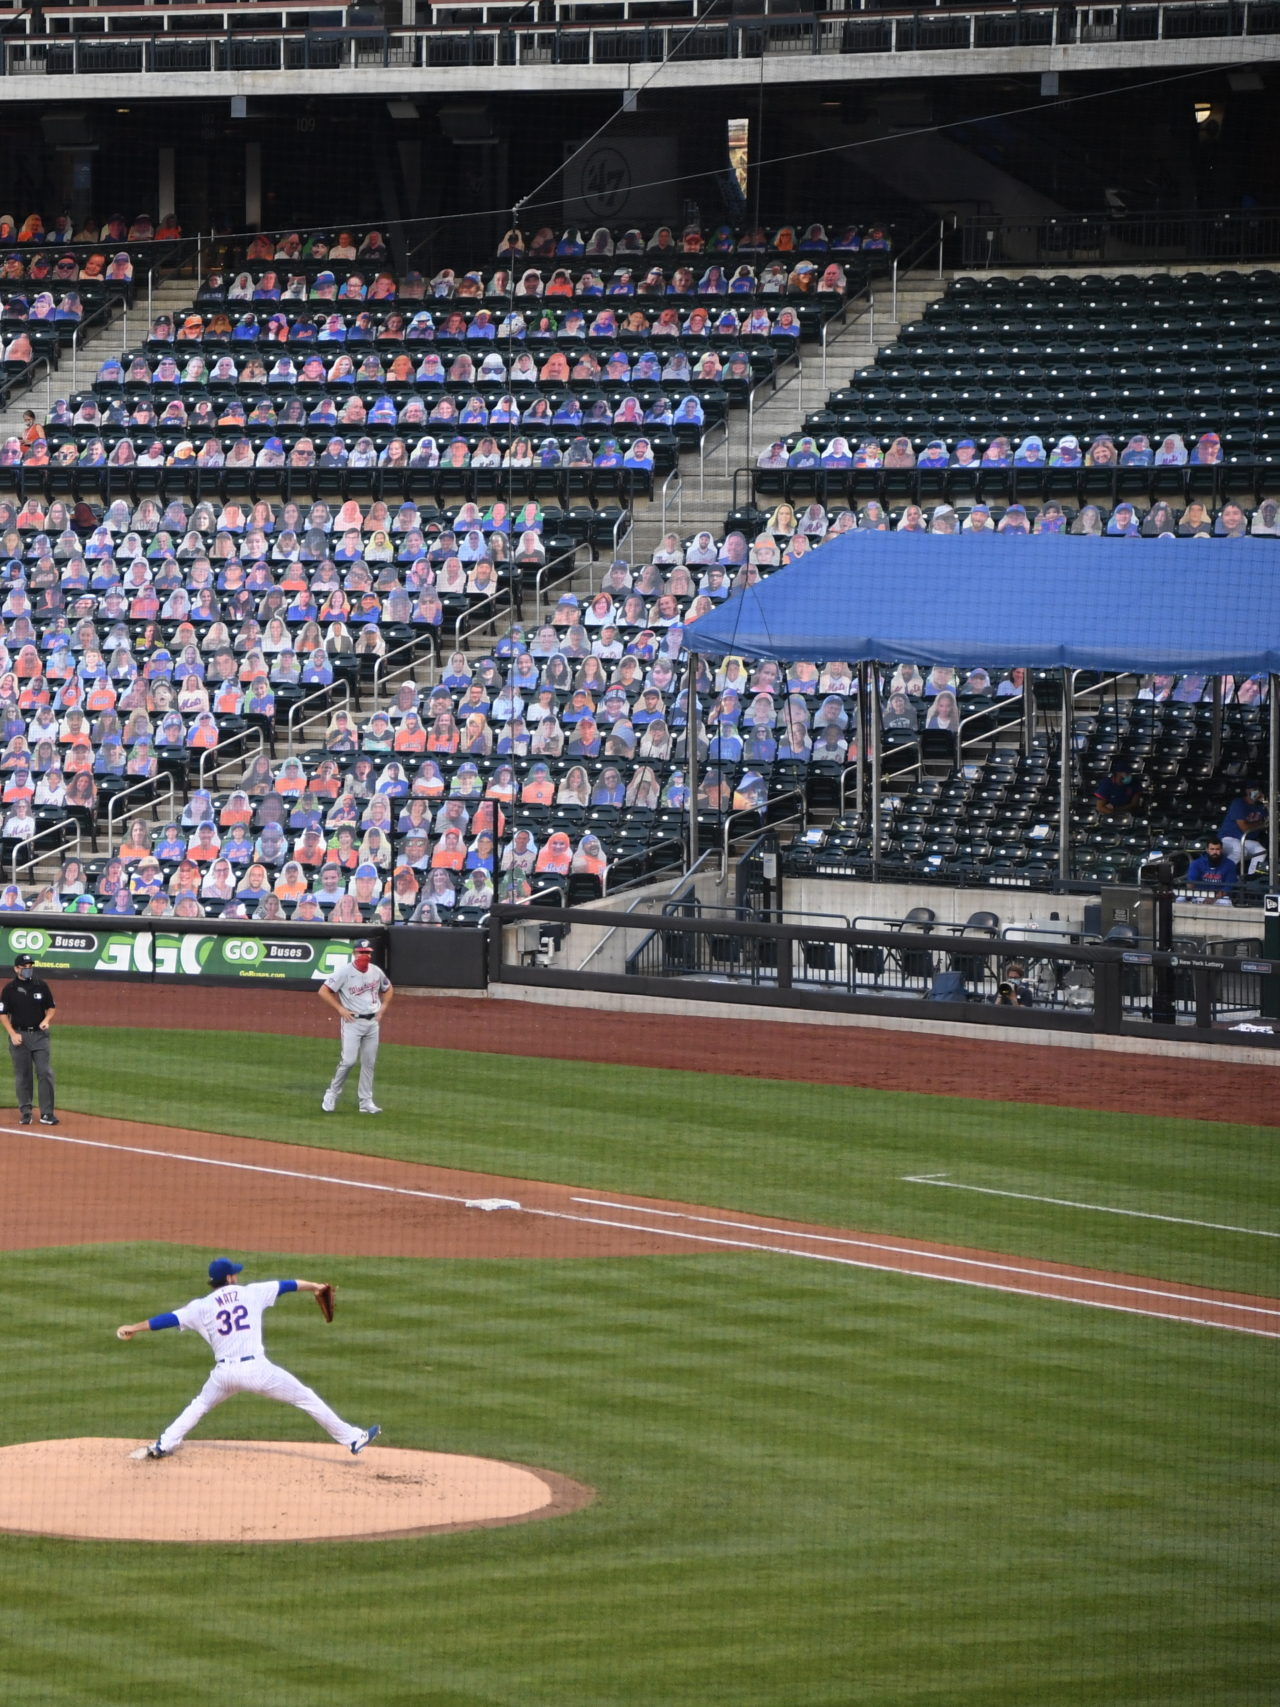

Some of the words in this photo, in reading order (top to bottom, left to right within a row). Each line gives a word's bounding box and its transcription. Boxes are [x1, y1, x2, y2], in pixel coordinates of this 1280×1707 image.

[180, 699, 202, 711] Mets
[11, 825, 31, 837] Mets
[510, 860, 528, 869] Mets
[467, 895, 487, 906] Mets
[11, 930, 43, 950] GO
[55, 935, 87, 948] Buses
[225, 940, 258, 960] GO
[270, 946, 302, 957] Buses
[32, 960, 70, 969] Buses.com
[1204, 961, 1224, 969] Lottery
[215, 1291, 240, 1307] MATZ
[215, 1304, 251, 1337] 32
